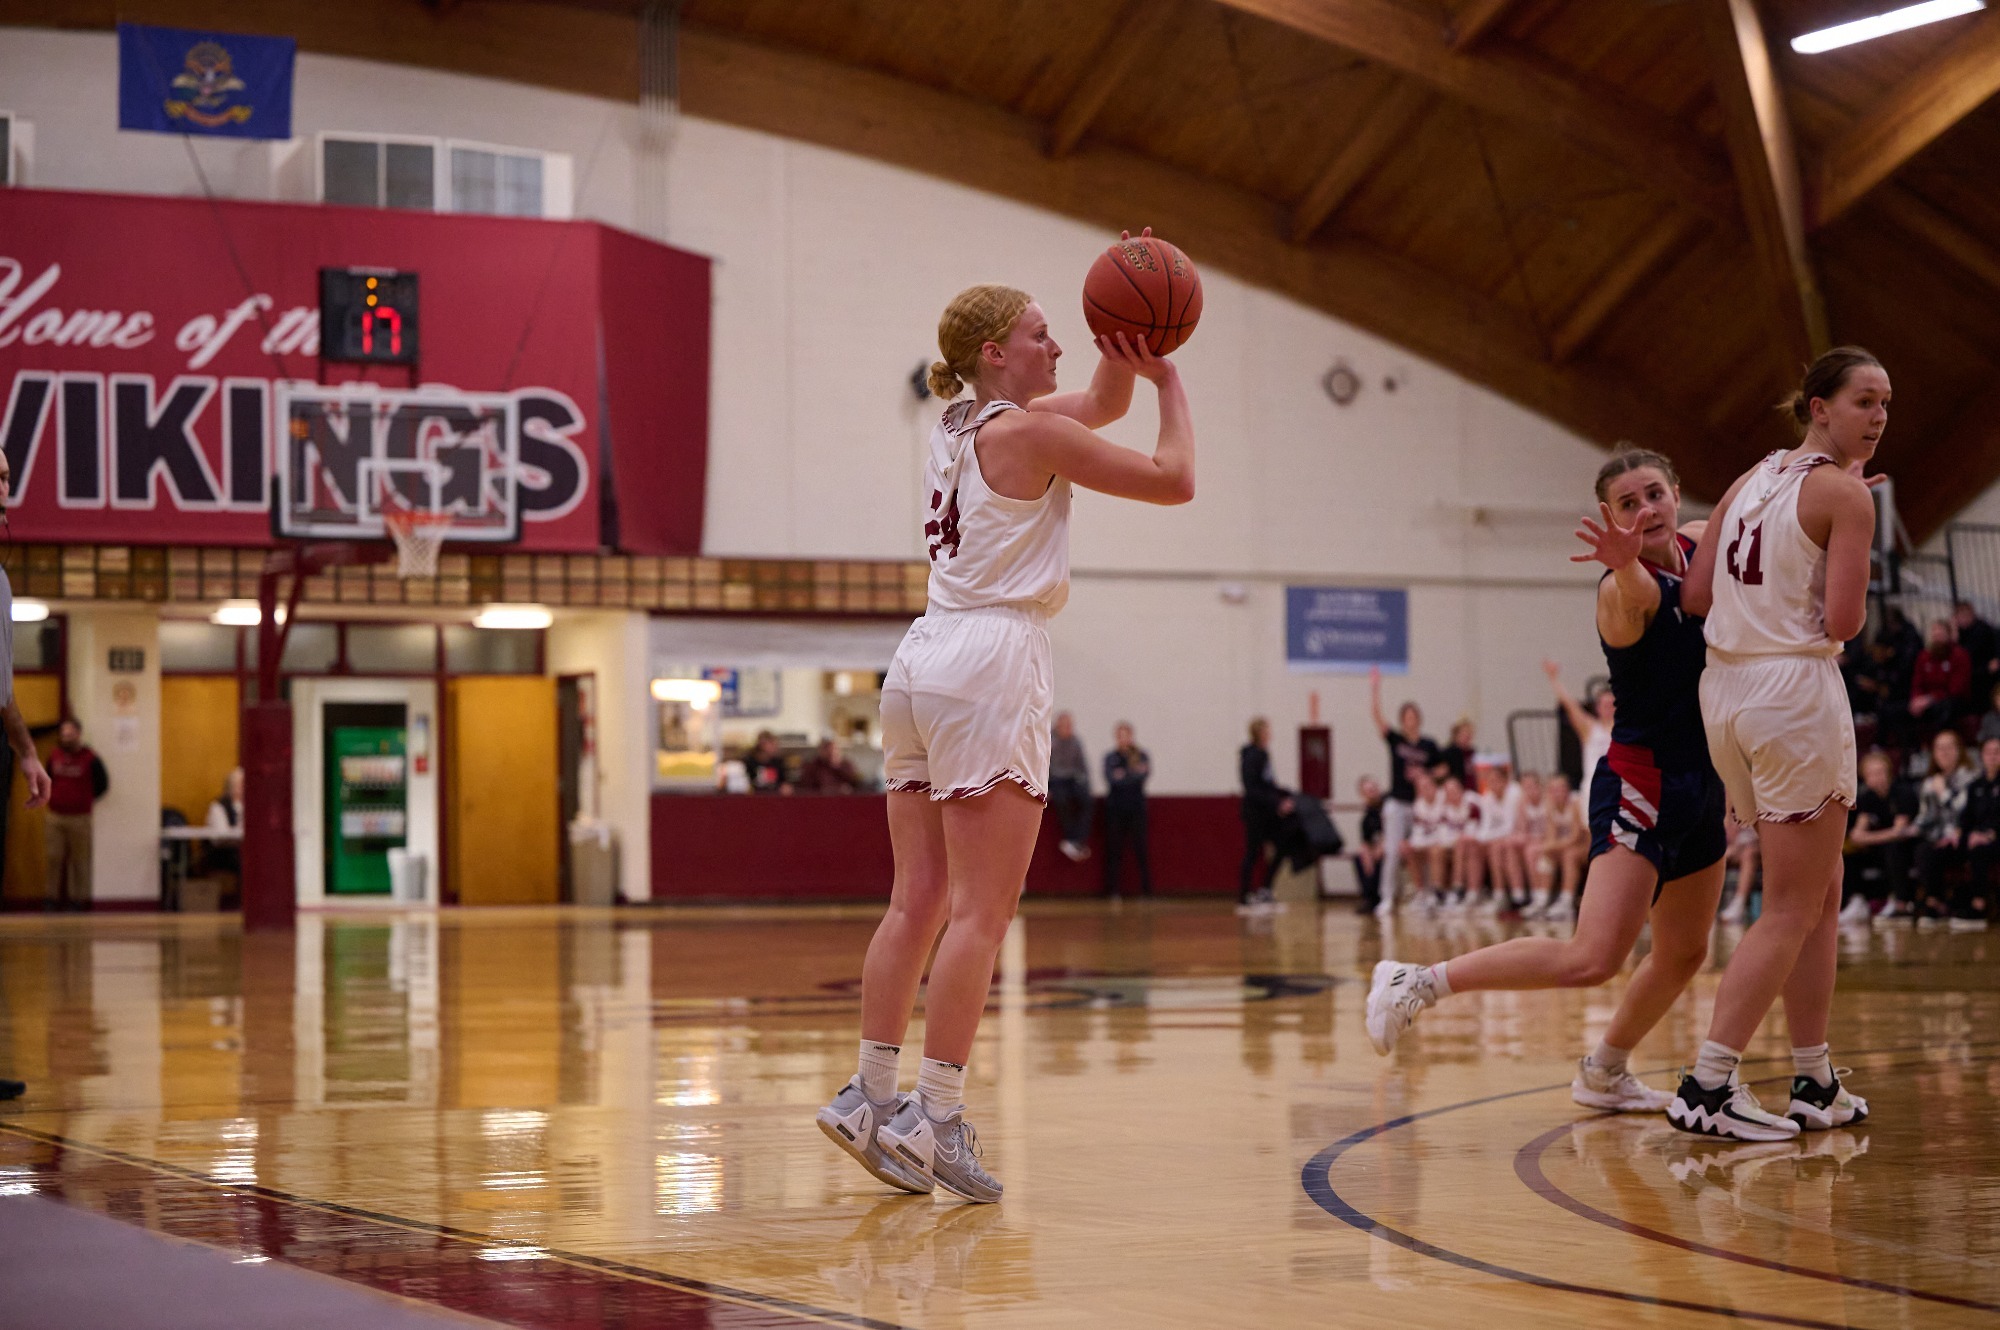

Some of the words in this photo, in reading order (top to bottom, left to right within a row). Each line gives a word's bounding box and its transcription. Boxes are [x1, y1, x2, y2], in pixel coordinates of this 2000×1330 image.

[175, 293, 273, 371] of
[261, 306, 320, 356] th
[361, 306, 402, 356] 17
